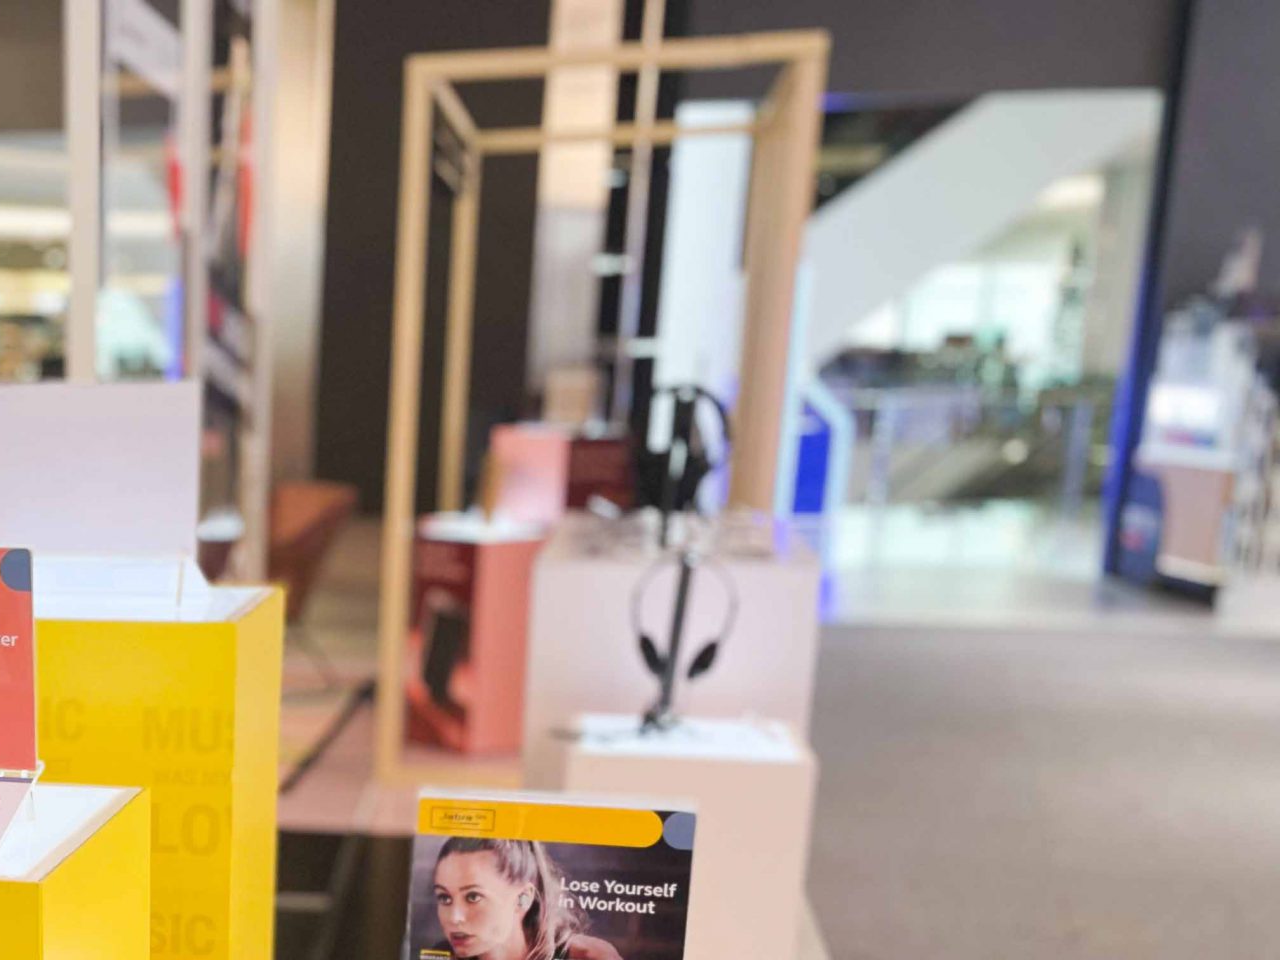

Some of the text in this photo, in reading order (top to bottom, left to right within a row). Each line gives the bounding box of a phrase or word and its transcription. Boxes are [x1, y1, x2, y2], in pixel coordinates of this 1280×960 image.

[560, 877, 677, 898] Lose Yourself
[558, 894, 655, 914] in Workout
